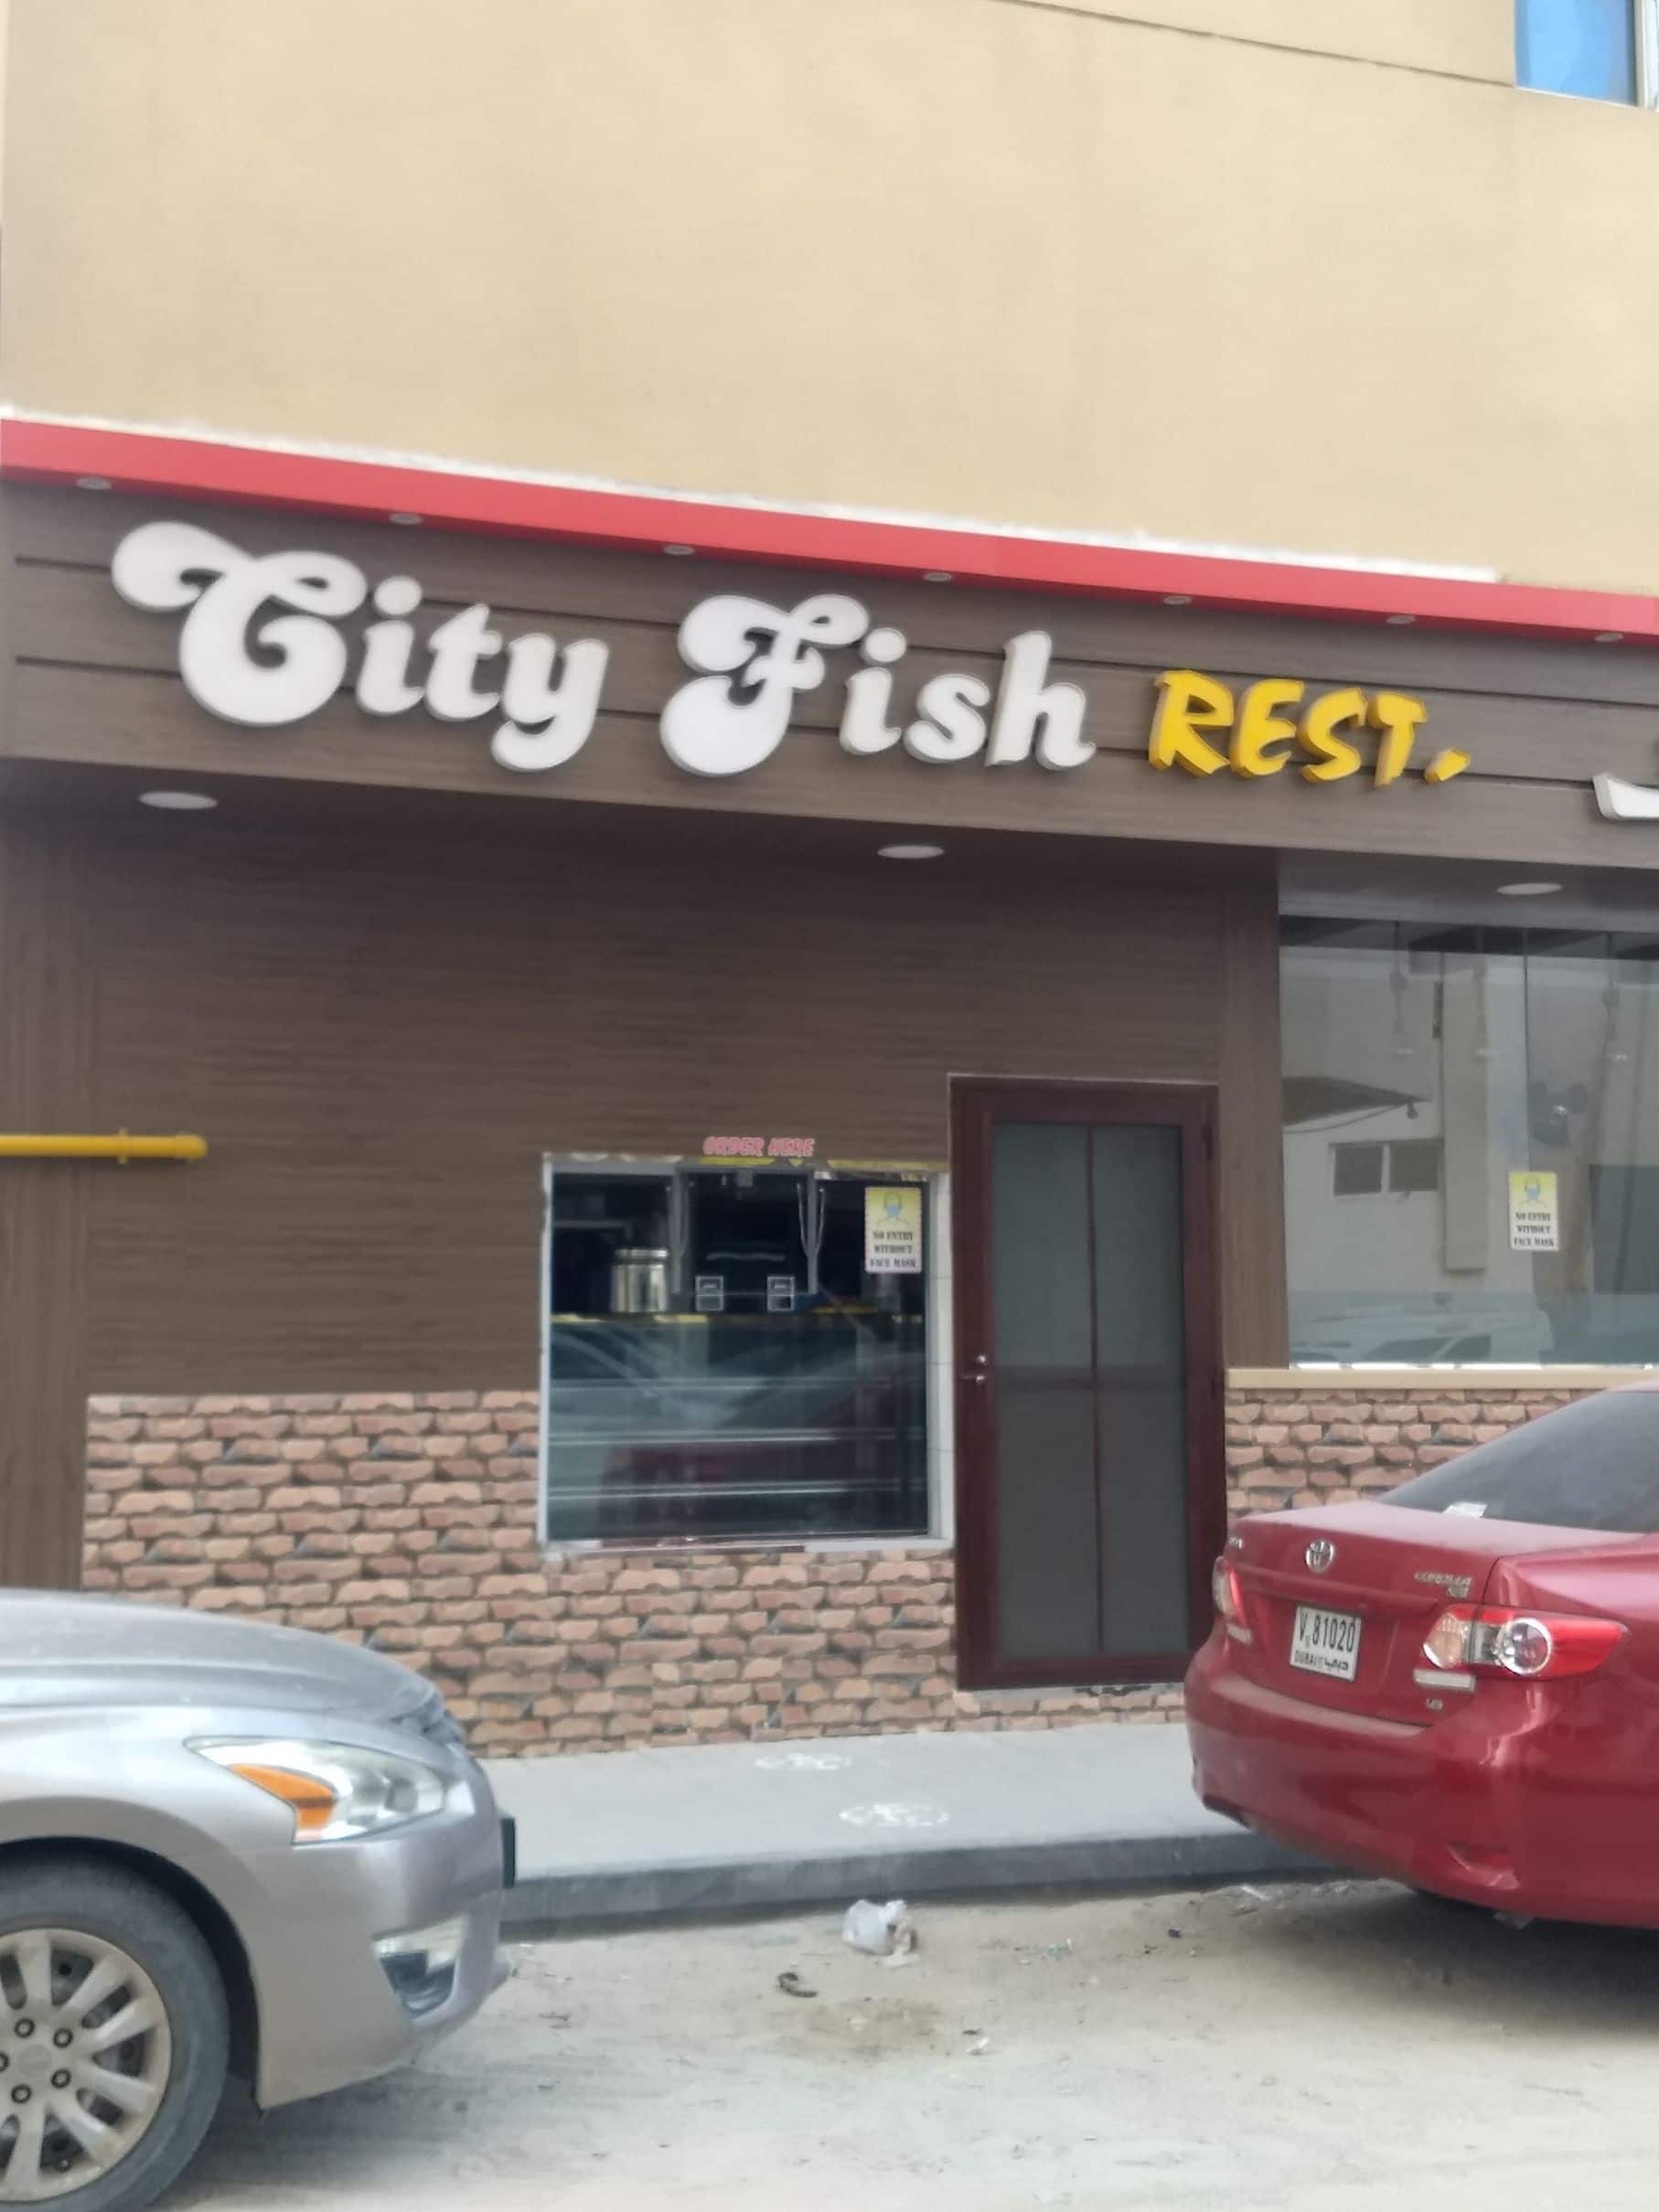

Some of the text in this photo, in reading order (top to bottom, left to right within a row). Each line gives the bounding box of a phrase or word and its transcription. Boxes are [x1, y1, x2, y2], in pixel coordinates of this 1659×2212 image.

[112, 521, 608, 773] City
[659, 593, 1097, 775] Fish
[1148, 669, 1471, 787] REST.
[1312, 1615, 1355, 1652] 81020
